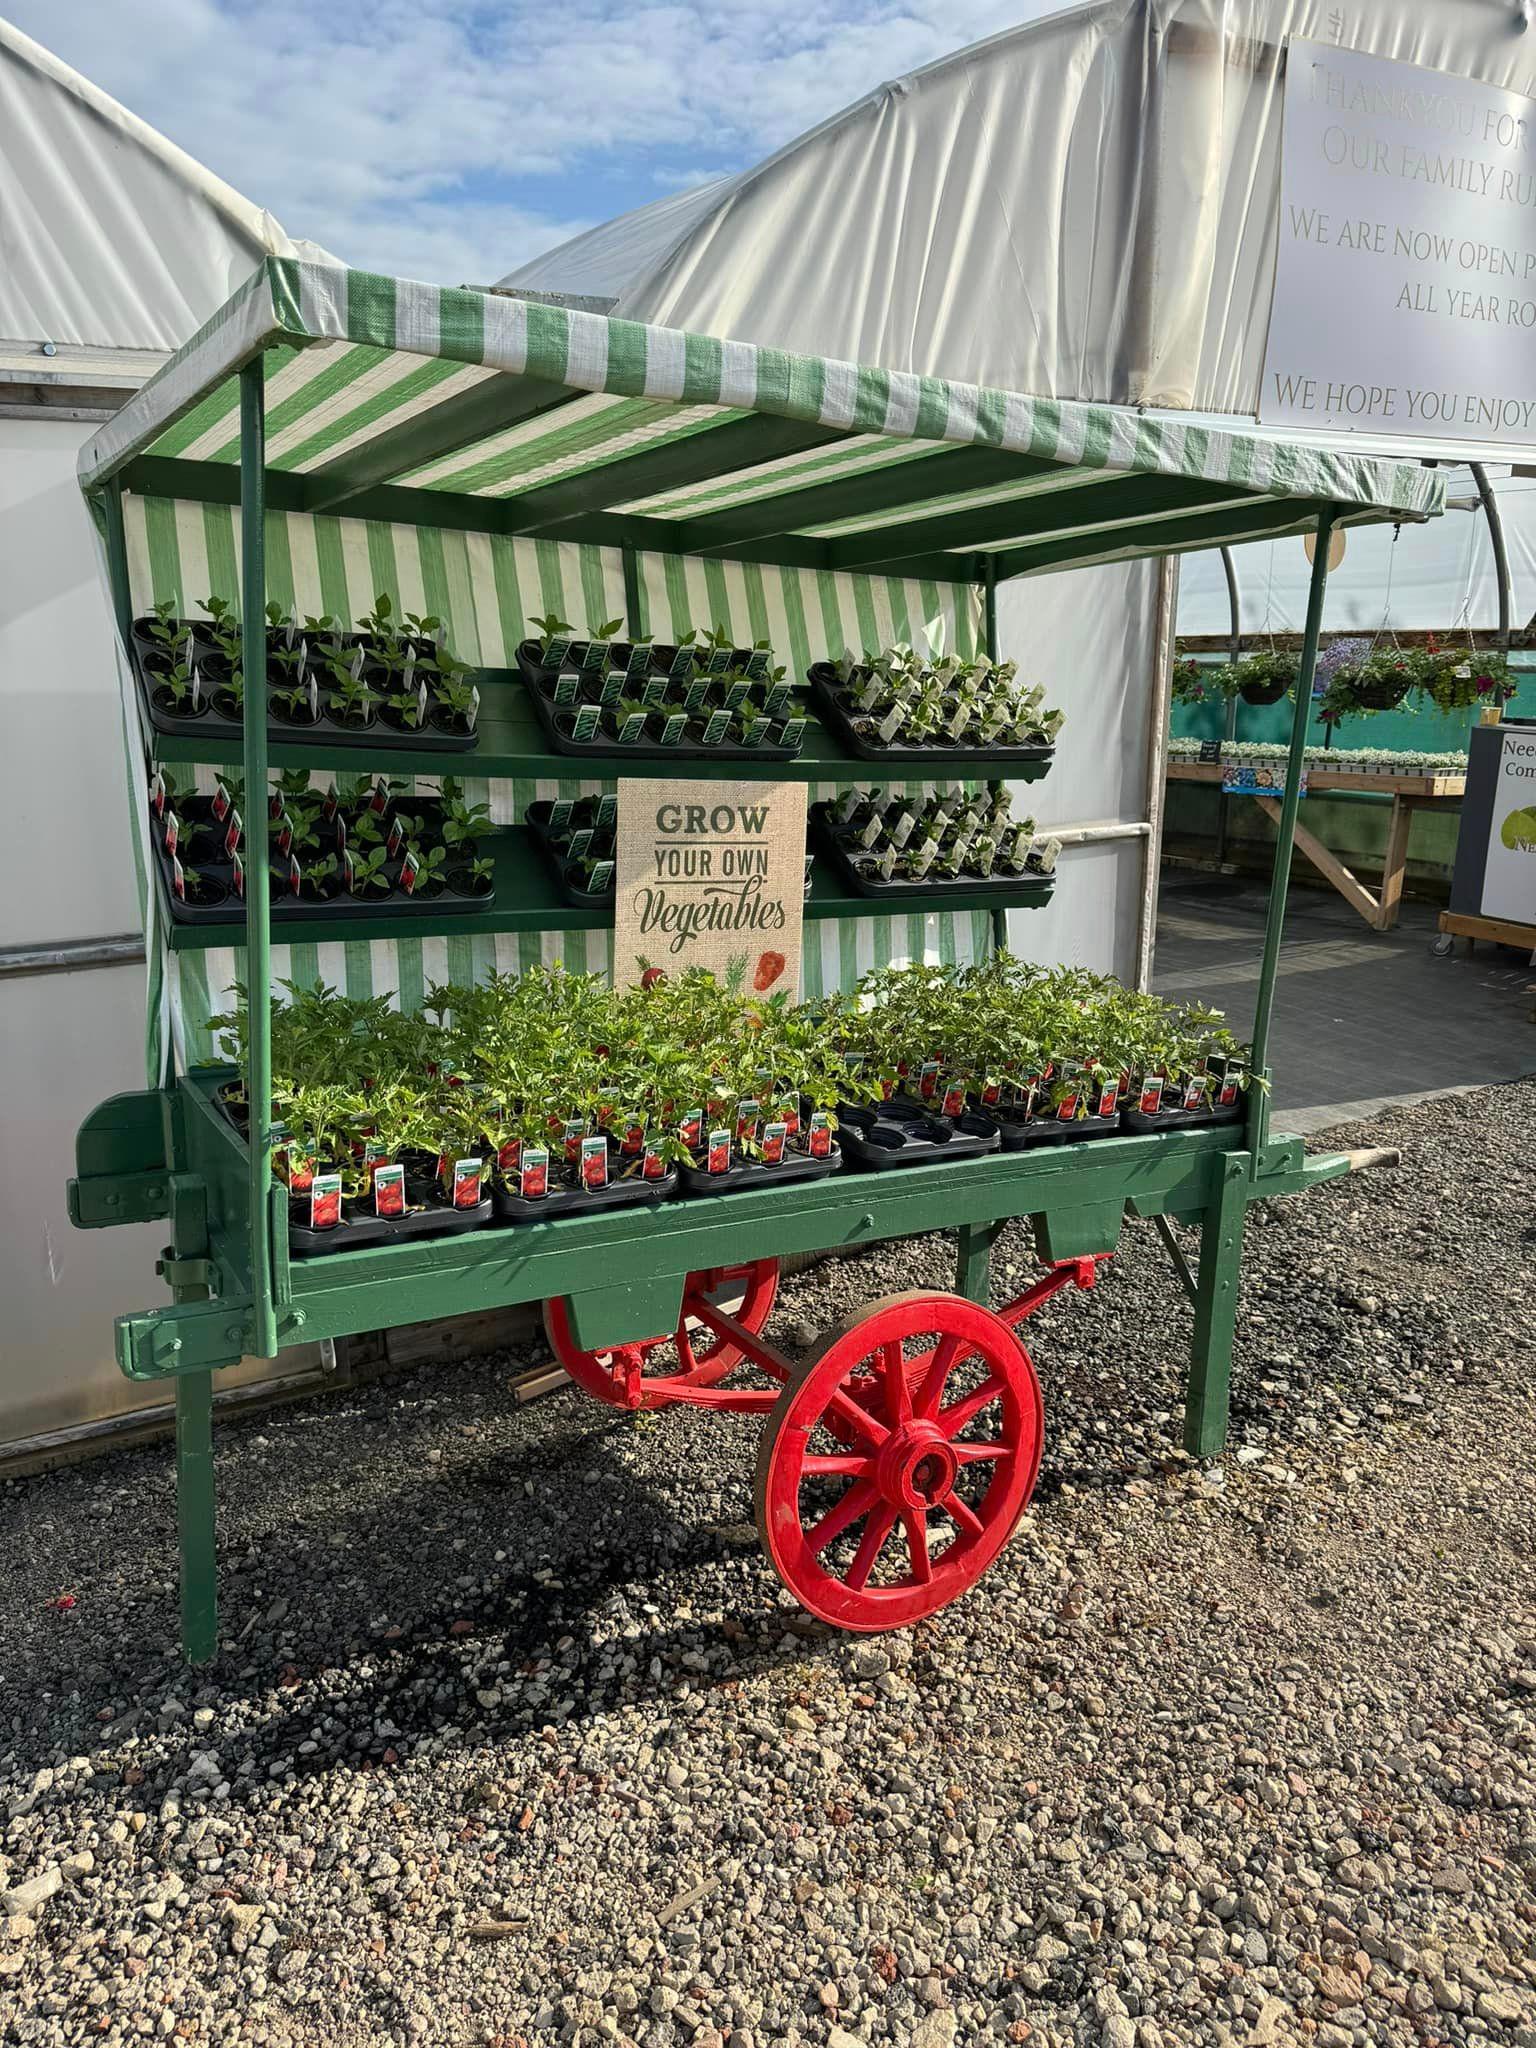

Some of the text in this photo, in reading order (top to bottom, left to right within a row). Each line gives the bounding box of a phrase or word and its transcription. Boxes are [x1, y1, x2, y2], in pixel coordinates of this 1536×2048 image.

[1303, 61, 1414, 122] THANK
[1483, 108, 1529, 152] FOR
[1323, 125, 1536, 207] OUR FAMILY RU
[1289, 204, 1330, 244] WE
[1336, 219, 1387, 254] ARE
[1394, 224, 1454, 264] NOW
[1459, 241, 1517, 277] OPEN
[1396, 282, 1438, 313] ALL
[1447, 288, 1500, 323] YEAR
[1274, 373, 1536, 433] WE HOPE YOU ENJOY
[1503, 740, 1536, 757] Nee
[656, 804, 769, 834] GROW
[654, 849, 769, 877] YOUR OWN
[633, 874, 786, 954] Vegetables
